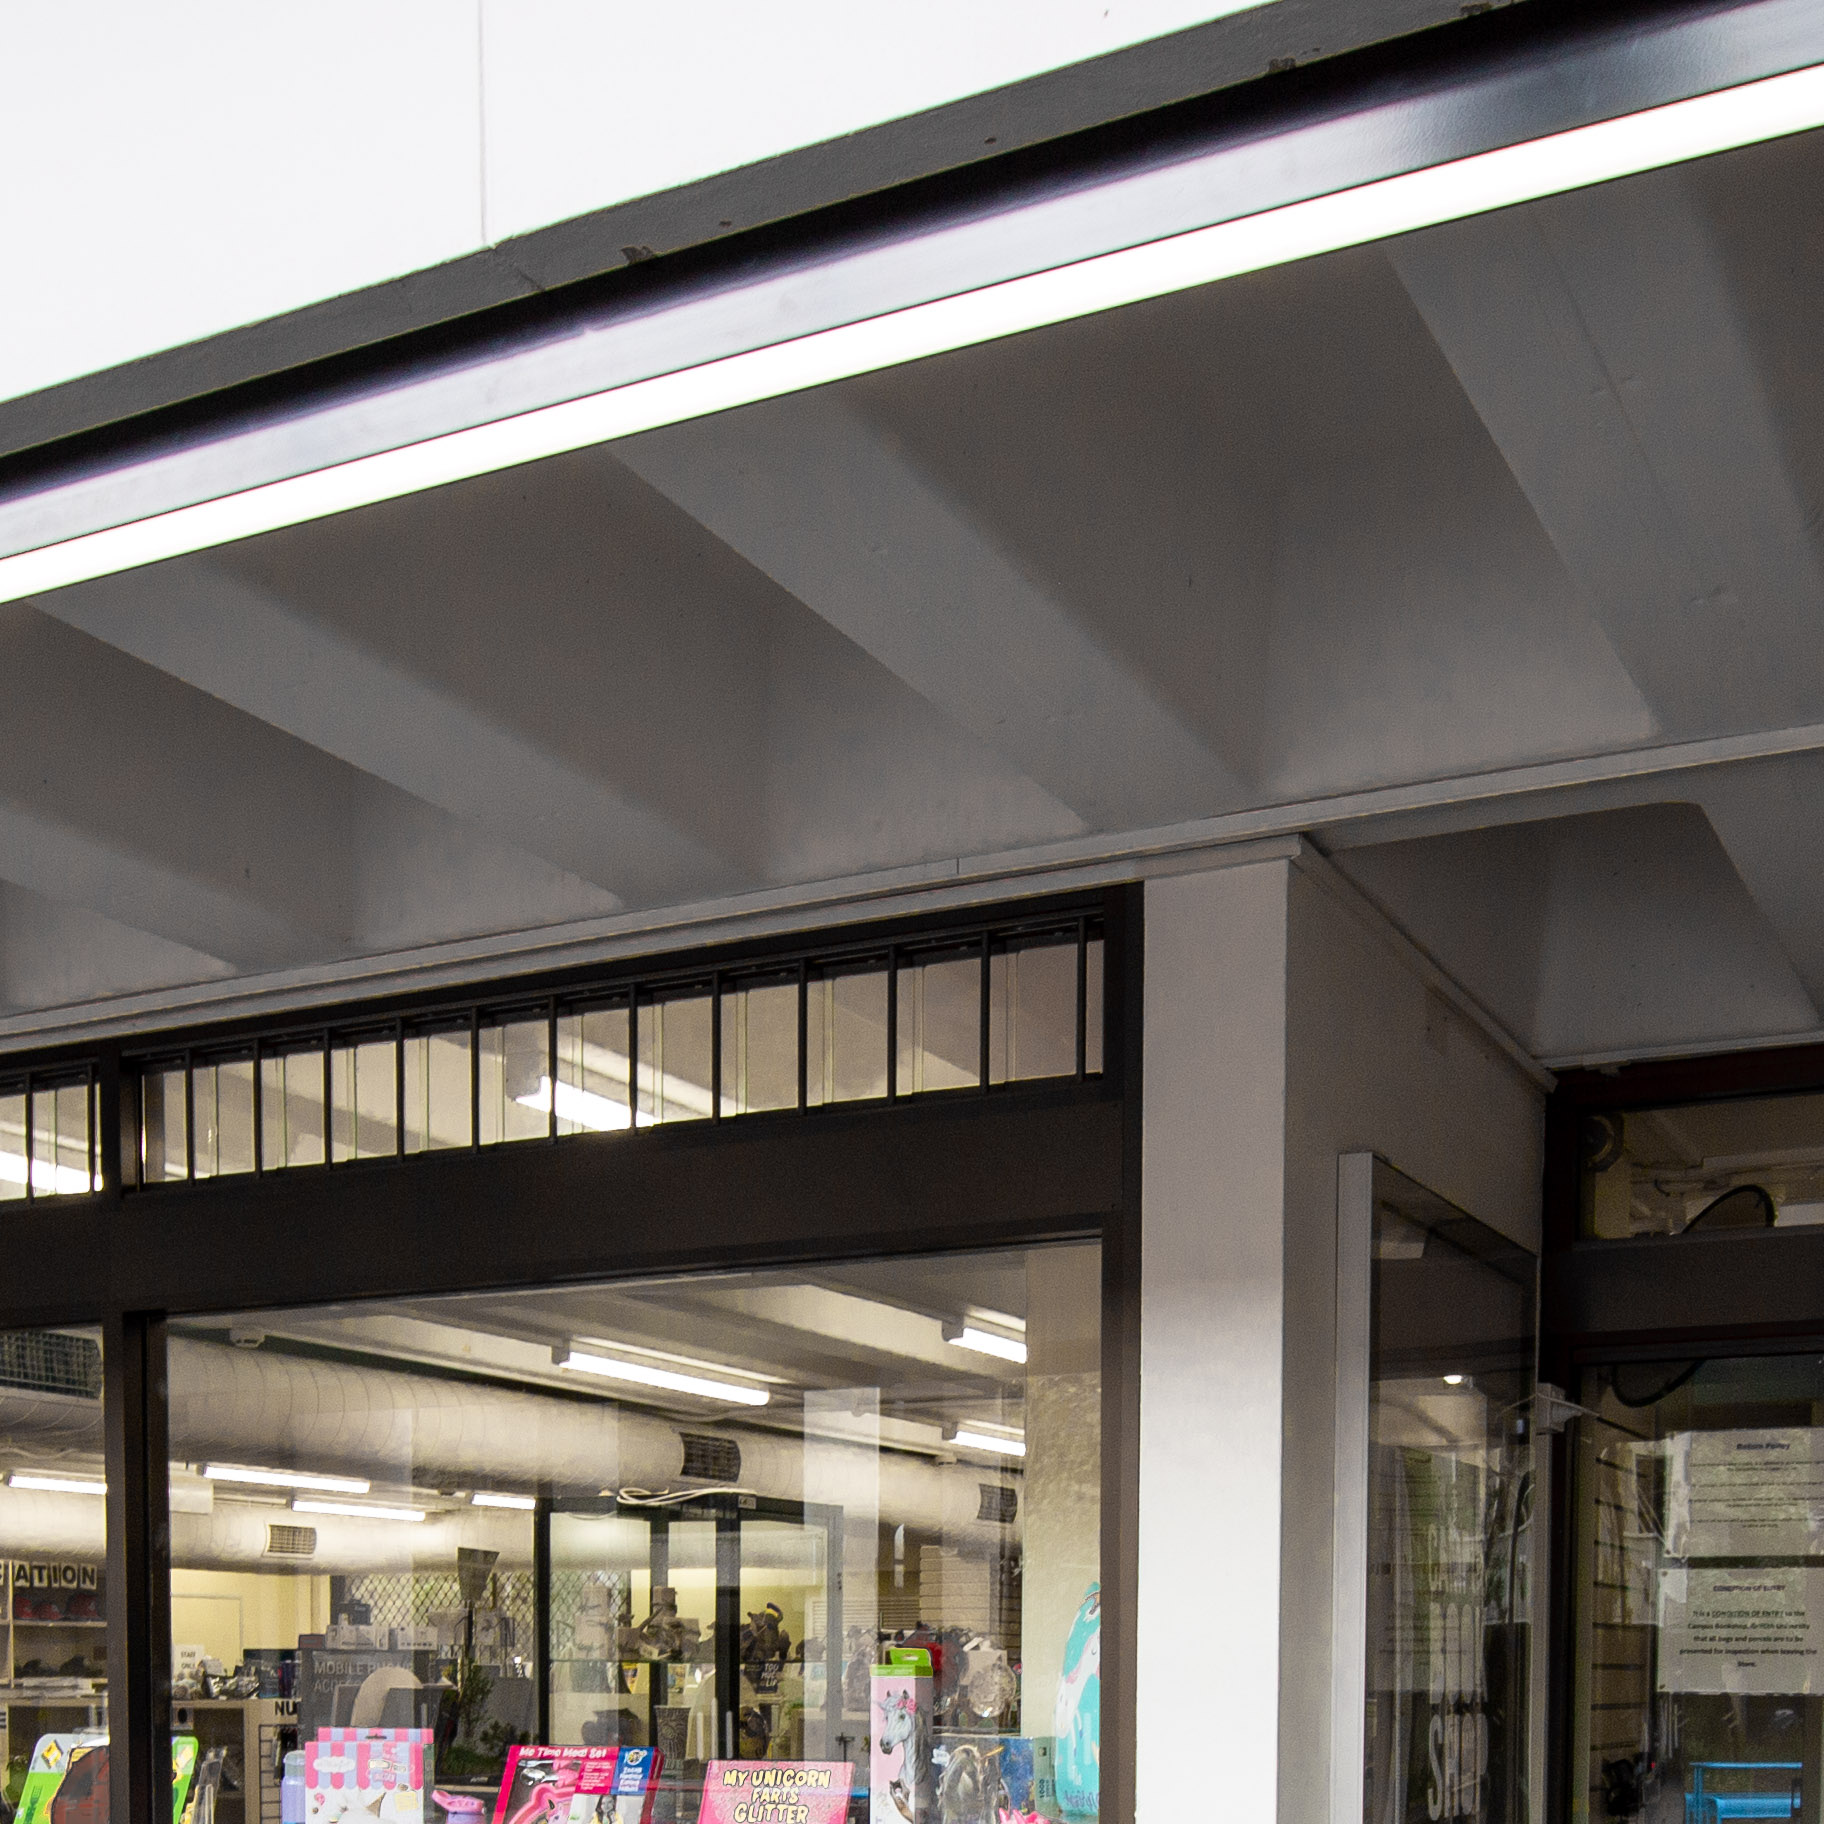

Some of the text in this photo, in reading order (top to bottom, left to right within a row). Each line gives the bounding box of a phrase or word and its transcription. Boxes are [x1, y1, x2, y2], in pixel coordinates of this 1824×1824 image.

[723, 1769, 832, 1789] MY UNICORN
[751, 1786, 800, 1804] FARTS
